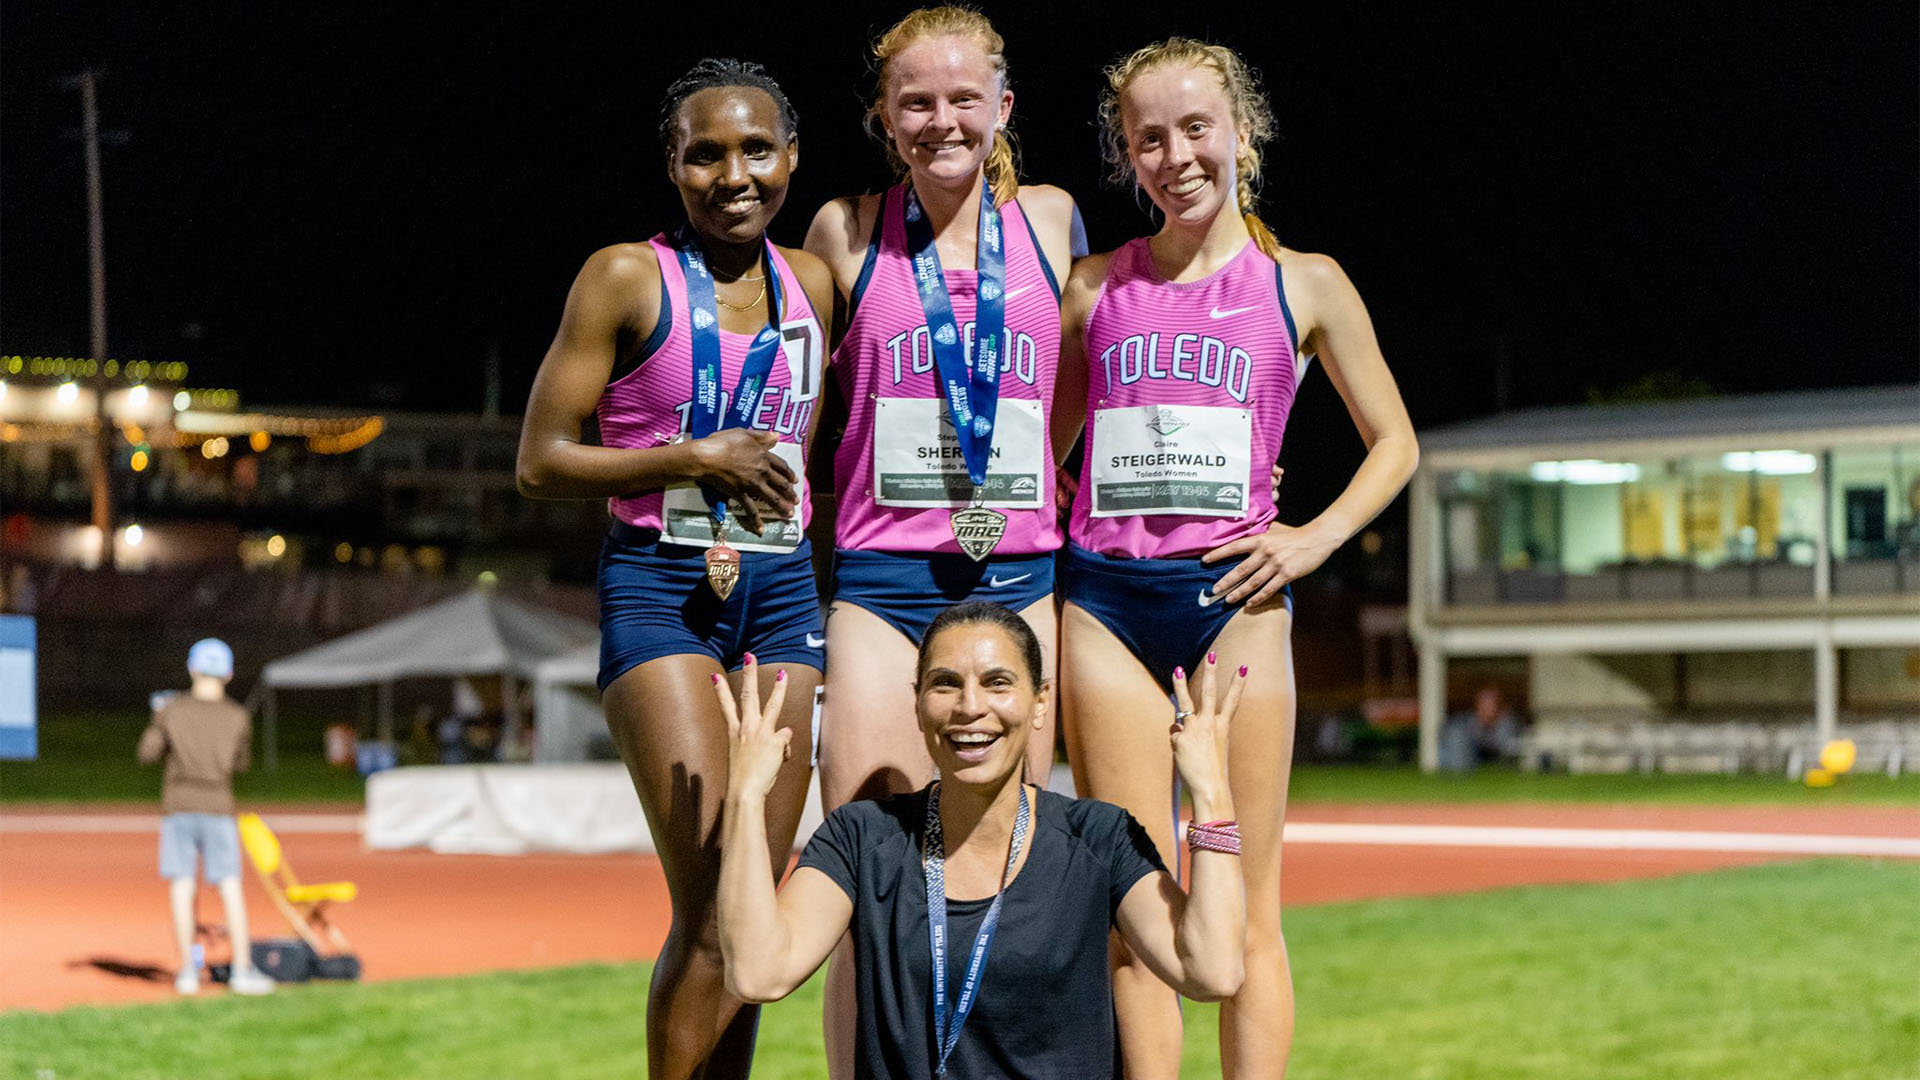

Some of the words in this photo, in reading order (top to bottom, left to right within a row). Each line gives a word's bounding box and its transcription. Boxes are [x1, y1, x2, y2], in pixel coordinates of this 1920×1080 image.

[782, 325, 812, 396] 7
[886, 321, 1037, 386] TOEO
[978, 337, 989, 373] GETSOME
[1100, 331, 1253, 404] TOLEDO
[698, 368, 708, 405] GETSOME
[674, 386, 813, 445] TEDO
[917, 446, 1001, 459] SHERN
[1111, 453, 1226, 468] STEIGERWALD
[1154, 440, 1178, 448] Claire
[926, 462, 957, 471] Toledo
[1135, 471, 1162, 479] Toledo
[1164, 469, 1198, 478] Women
